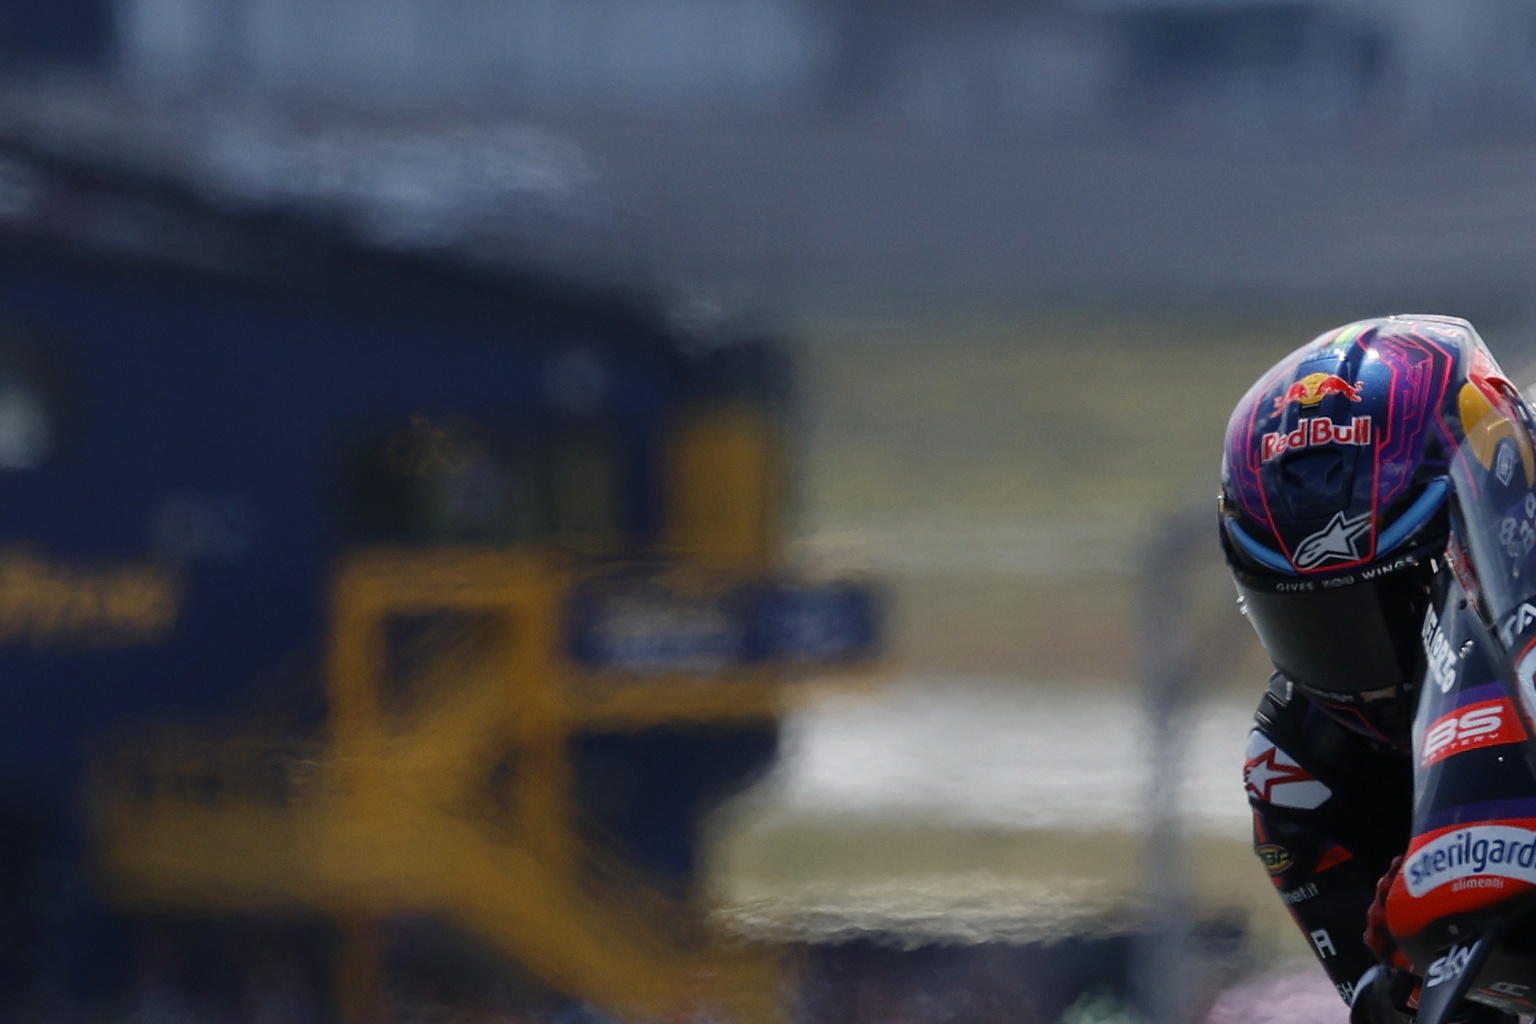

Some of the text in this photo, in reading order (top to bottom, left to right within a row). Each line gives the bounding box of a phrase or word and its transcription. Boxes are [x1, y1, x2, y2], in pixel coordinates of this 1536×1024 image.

[1262, 416, 1372, 461] Red Bull
[1423, 706, 1504, 758] BS
